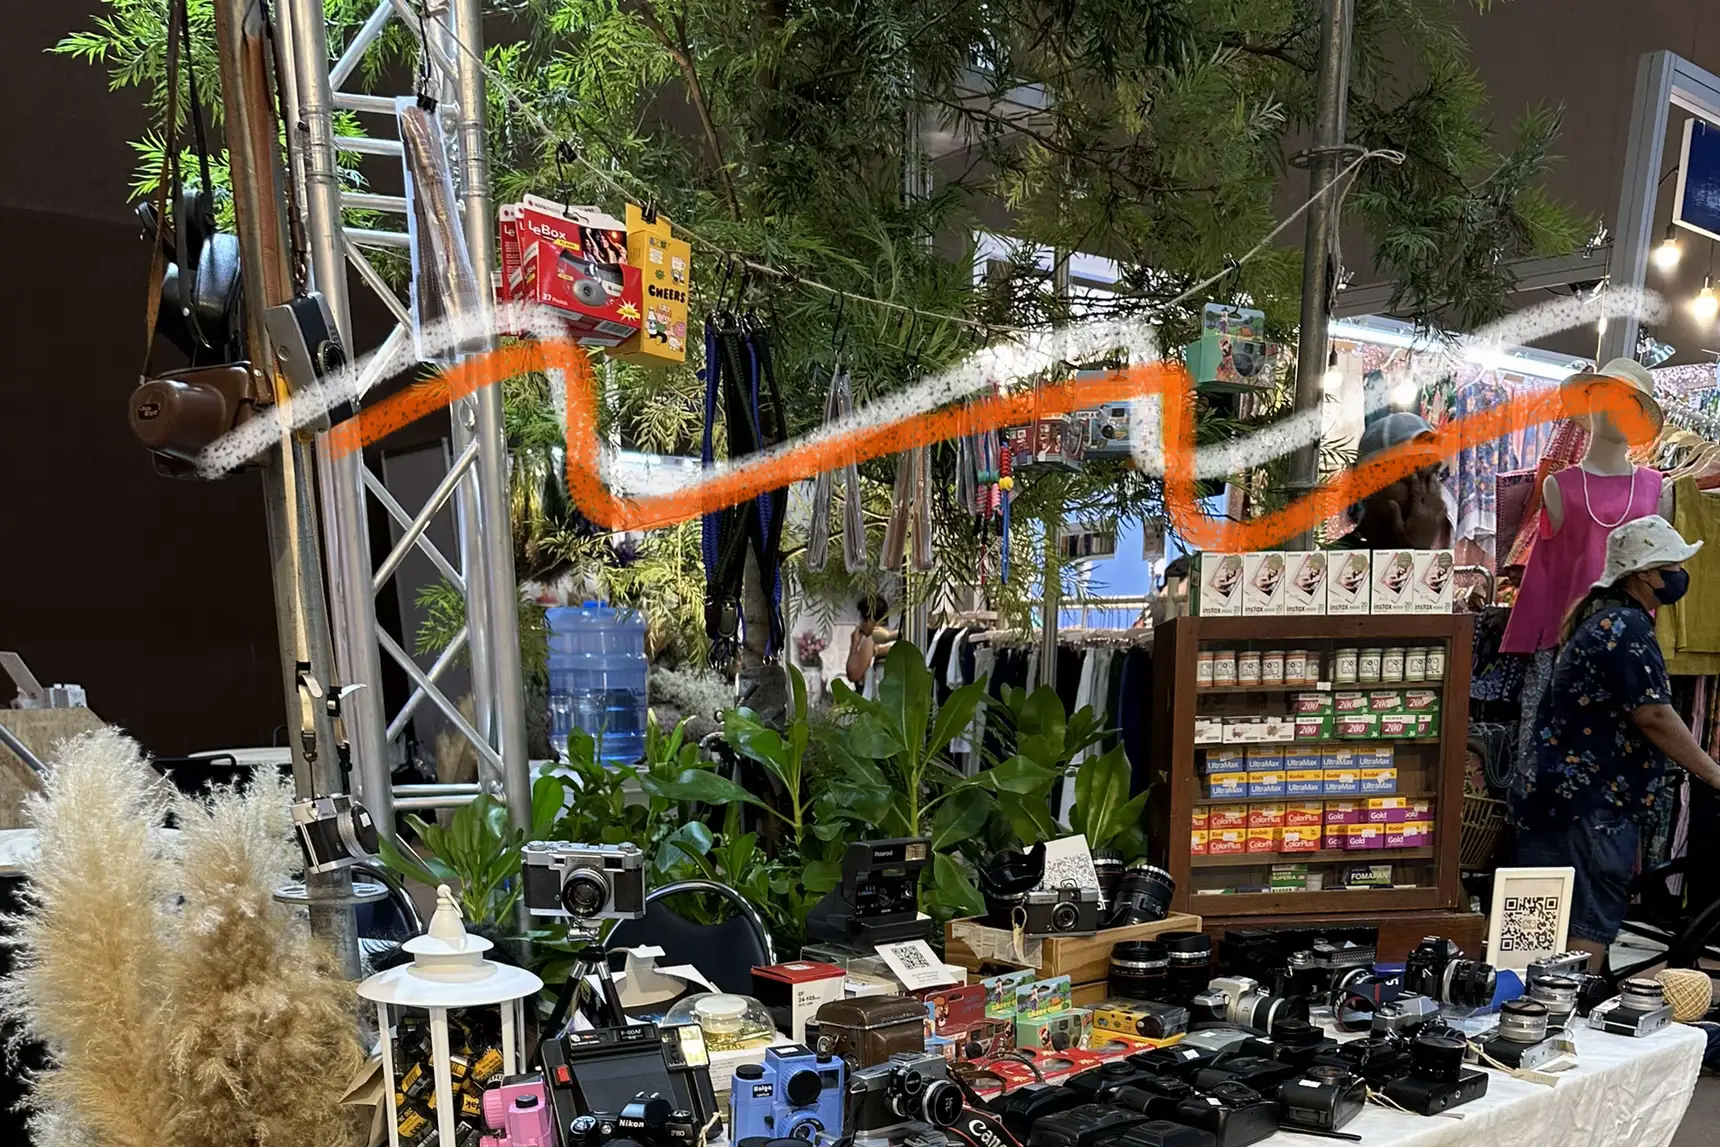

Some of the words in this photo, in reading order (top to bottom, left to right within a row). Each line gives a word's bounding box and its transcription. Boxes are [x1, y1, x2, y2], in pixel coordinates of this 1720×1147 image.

[528, 220, 567, 240] LeBox
[542, 292, 553, 302] 27
[648, 284, 686, 303] CHEERS
[1302, 701, 1319, 710] 200
[1408, 698, 1425, 707] 200
[1299, 725, 1317, 734] 200
[1347, 724, 1365, 733] 200
[1384, 723, 1402, 732] 200
[1208, 760, 1239, 769] UltraMax
[1249, 759, 1280, 768] UltraMax
[1287, 758, 1317, 767] UltraMax
[1323, 758, 1354, 766] UltraMax
[1359, 757, 1390, 765] UltraMax
[1251, 785, 1282, 793] UltraMax
[1288, 783, 1319, 792] UltraMax
[1325, 782, 1356, 791] UltraMax
[1363, 781, 1393, 790] UltraMax
[1212, 786, 1243, 795] UltraMax
[1250, 815, 1281, 824] ColorPlus
[1288, 814, 1319, 822] ColorPlus
[1328, 812, 1344, 820] Gold
[1370, 811, 1388, 819] Gold
[1212, 817, 1242, 825] ColorPlus
[1284, 840, 1315, 848] ColorPlus
[1349, 837, 1366, 845] Gold
[1387, 835, 1404, 844] Gold
[1211, 842, 1241, 850] ColorPlus
[1249, 841, 1272, 849] ColorPl
[1350, 872, 1389, 880] FOMAPAN
[753, 1084, 772, 1093] Holga
[619, 1119, 645, 1128] Nikon
